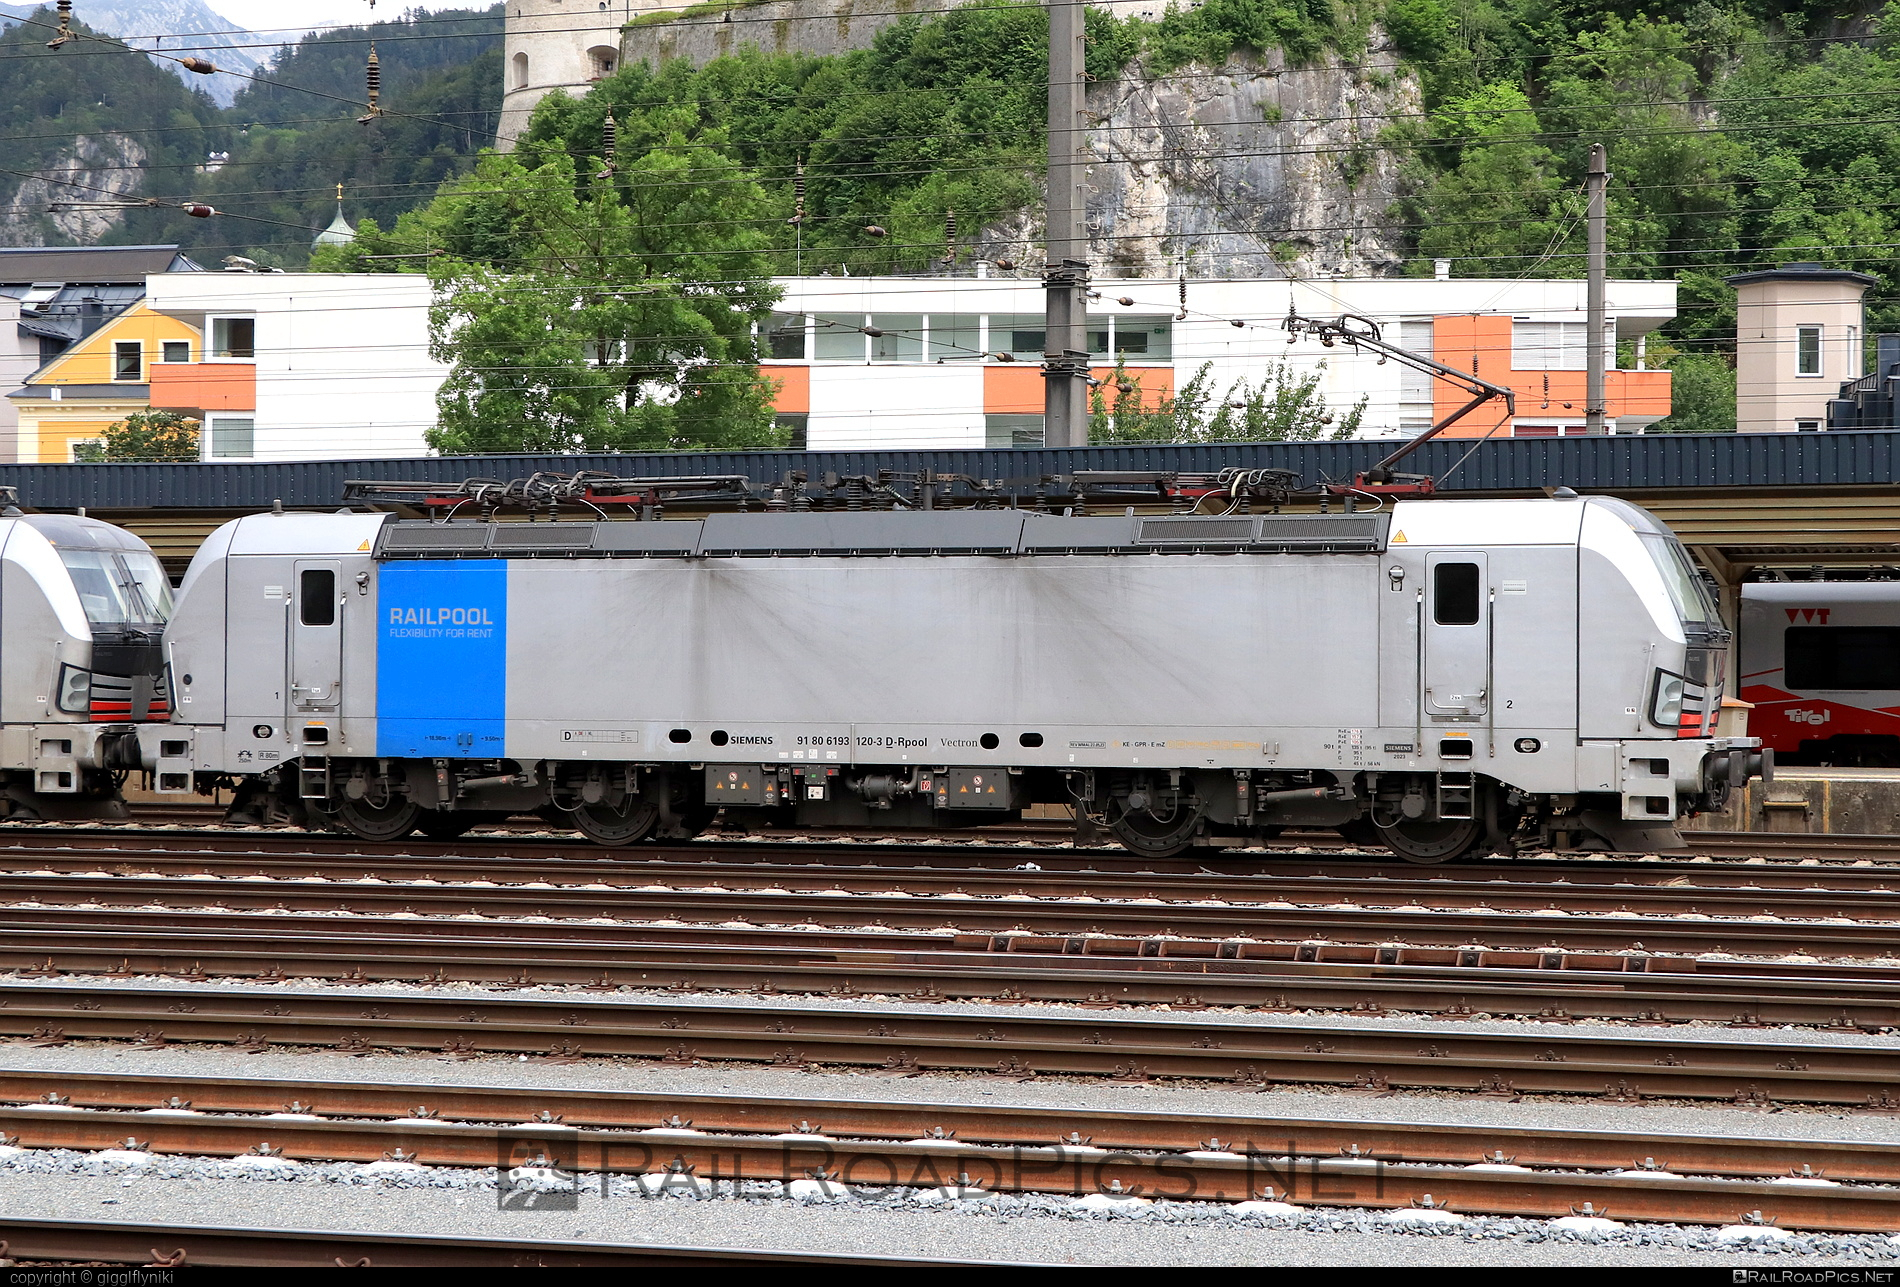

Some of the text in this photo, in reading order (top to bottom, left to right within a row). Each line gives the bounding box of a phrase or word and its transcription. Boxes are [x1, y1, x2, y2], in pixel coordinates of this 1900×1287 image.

[390, 607, 493, 625] RAILPOOL
[389, 628, 493, 638] FLEXIBILITY FOR RENT
[274, 692, 279, 700] 1
[1506, 700, 1513, 709] 2
[1784, 709, 1831, 725] Tirol
[564, 731, 572, 741] D
[730, 736, 773, 745] SIEMENS
[797, 736, 928, 749] 91 80 6193 120-3 D-Rpool
[940, 738, 978, 748] Vectron
